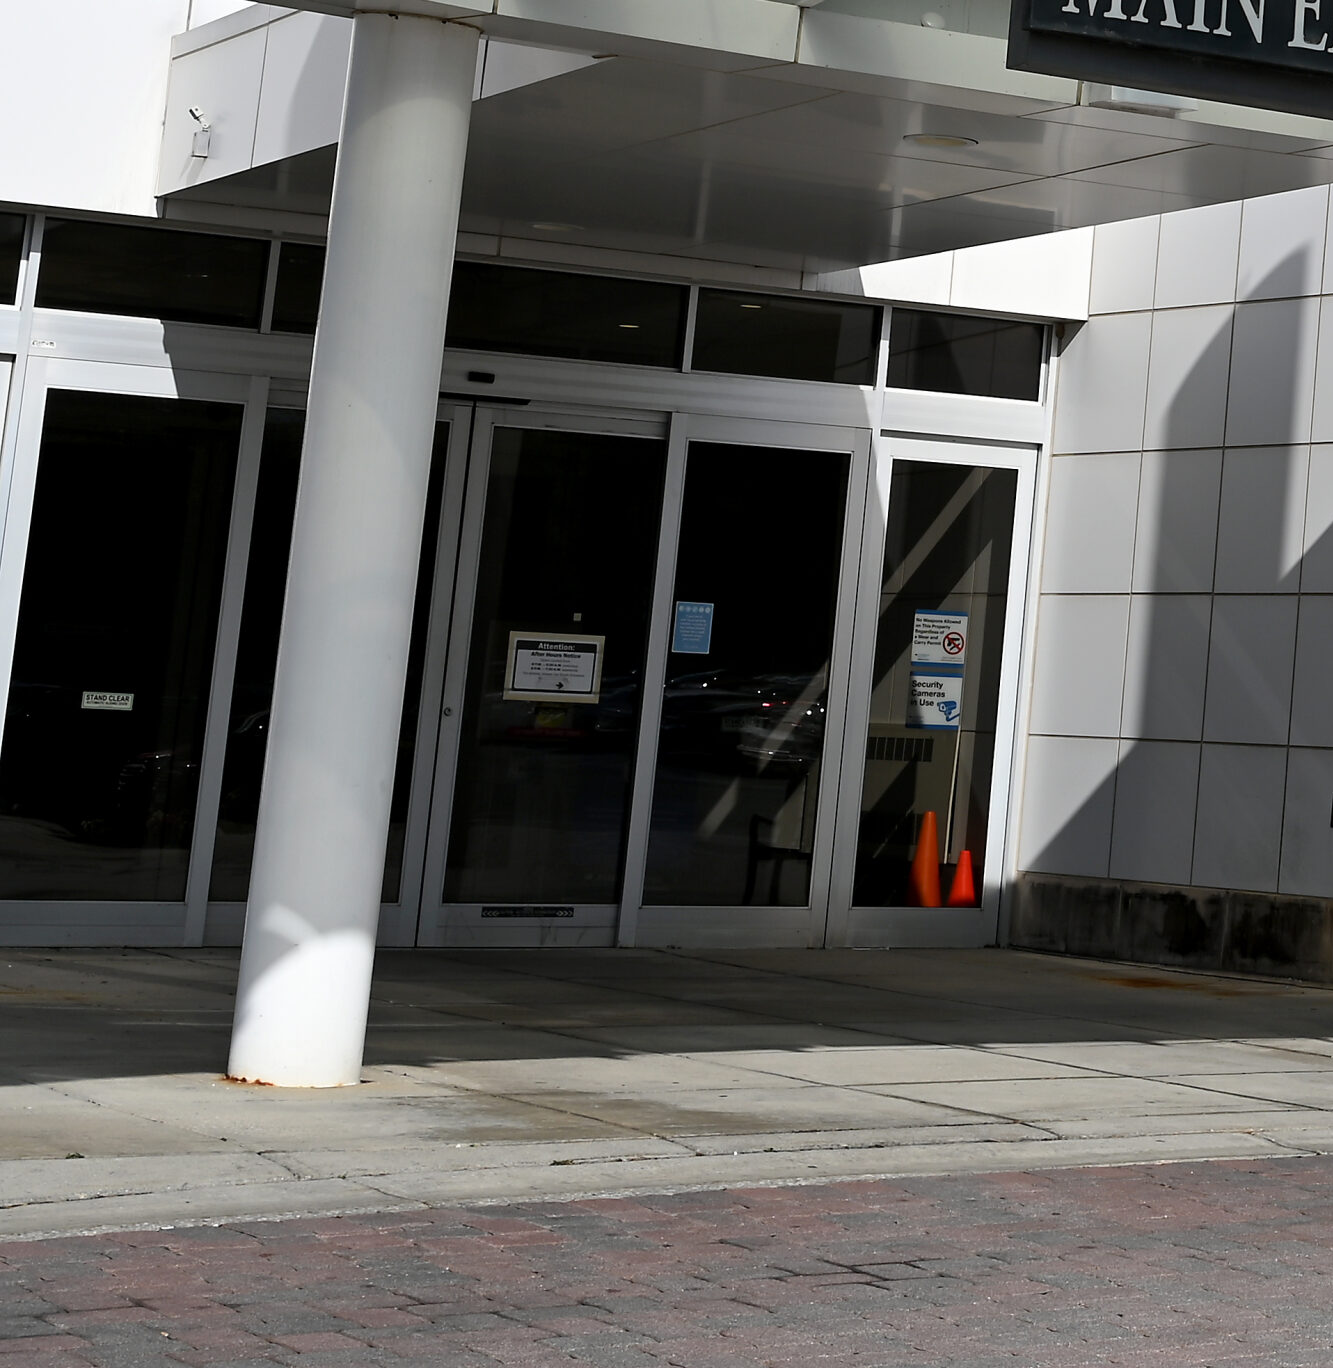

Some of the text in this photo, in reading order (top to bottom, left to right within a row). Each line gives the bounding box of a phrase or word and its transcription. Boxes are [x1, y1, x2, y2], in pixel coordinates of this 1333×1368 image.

[911, 680, 944, 689] Security
[911, 689, 946, 698] Cameras
[919, 698, 935, 706] Use
